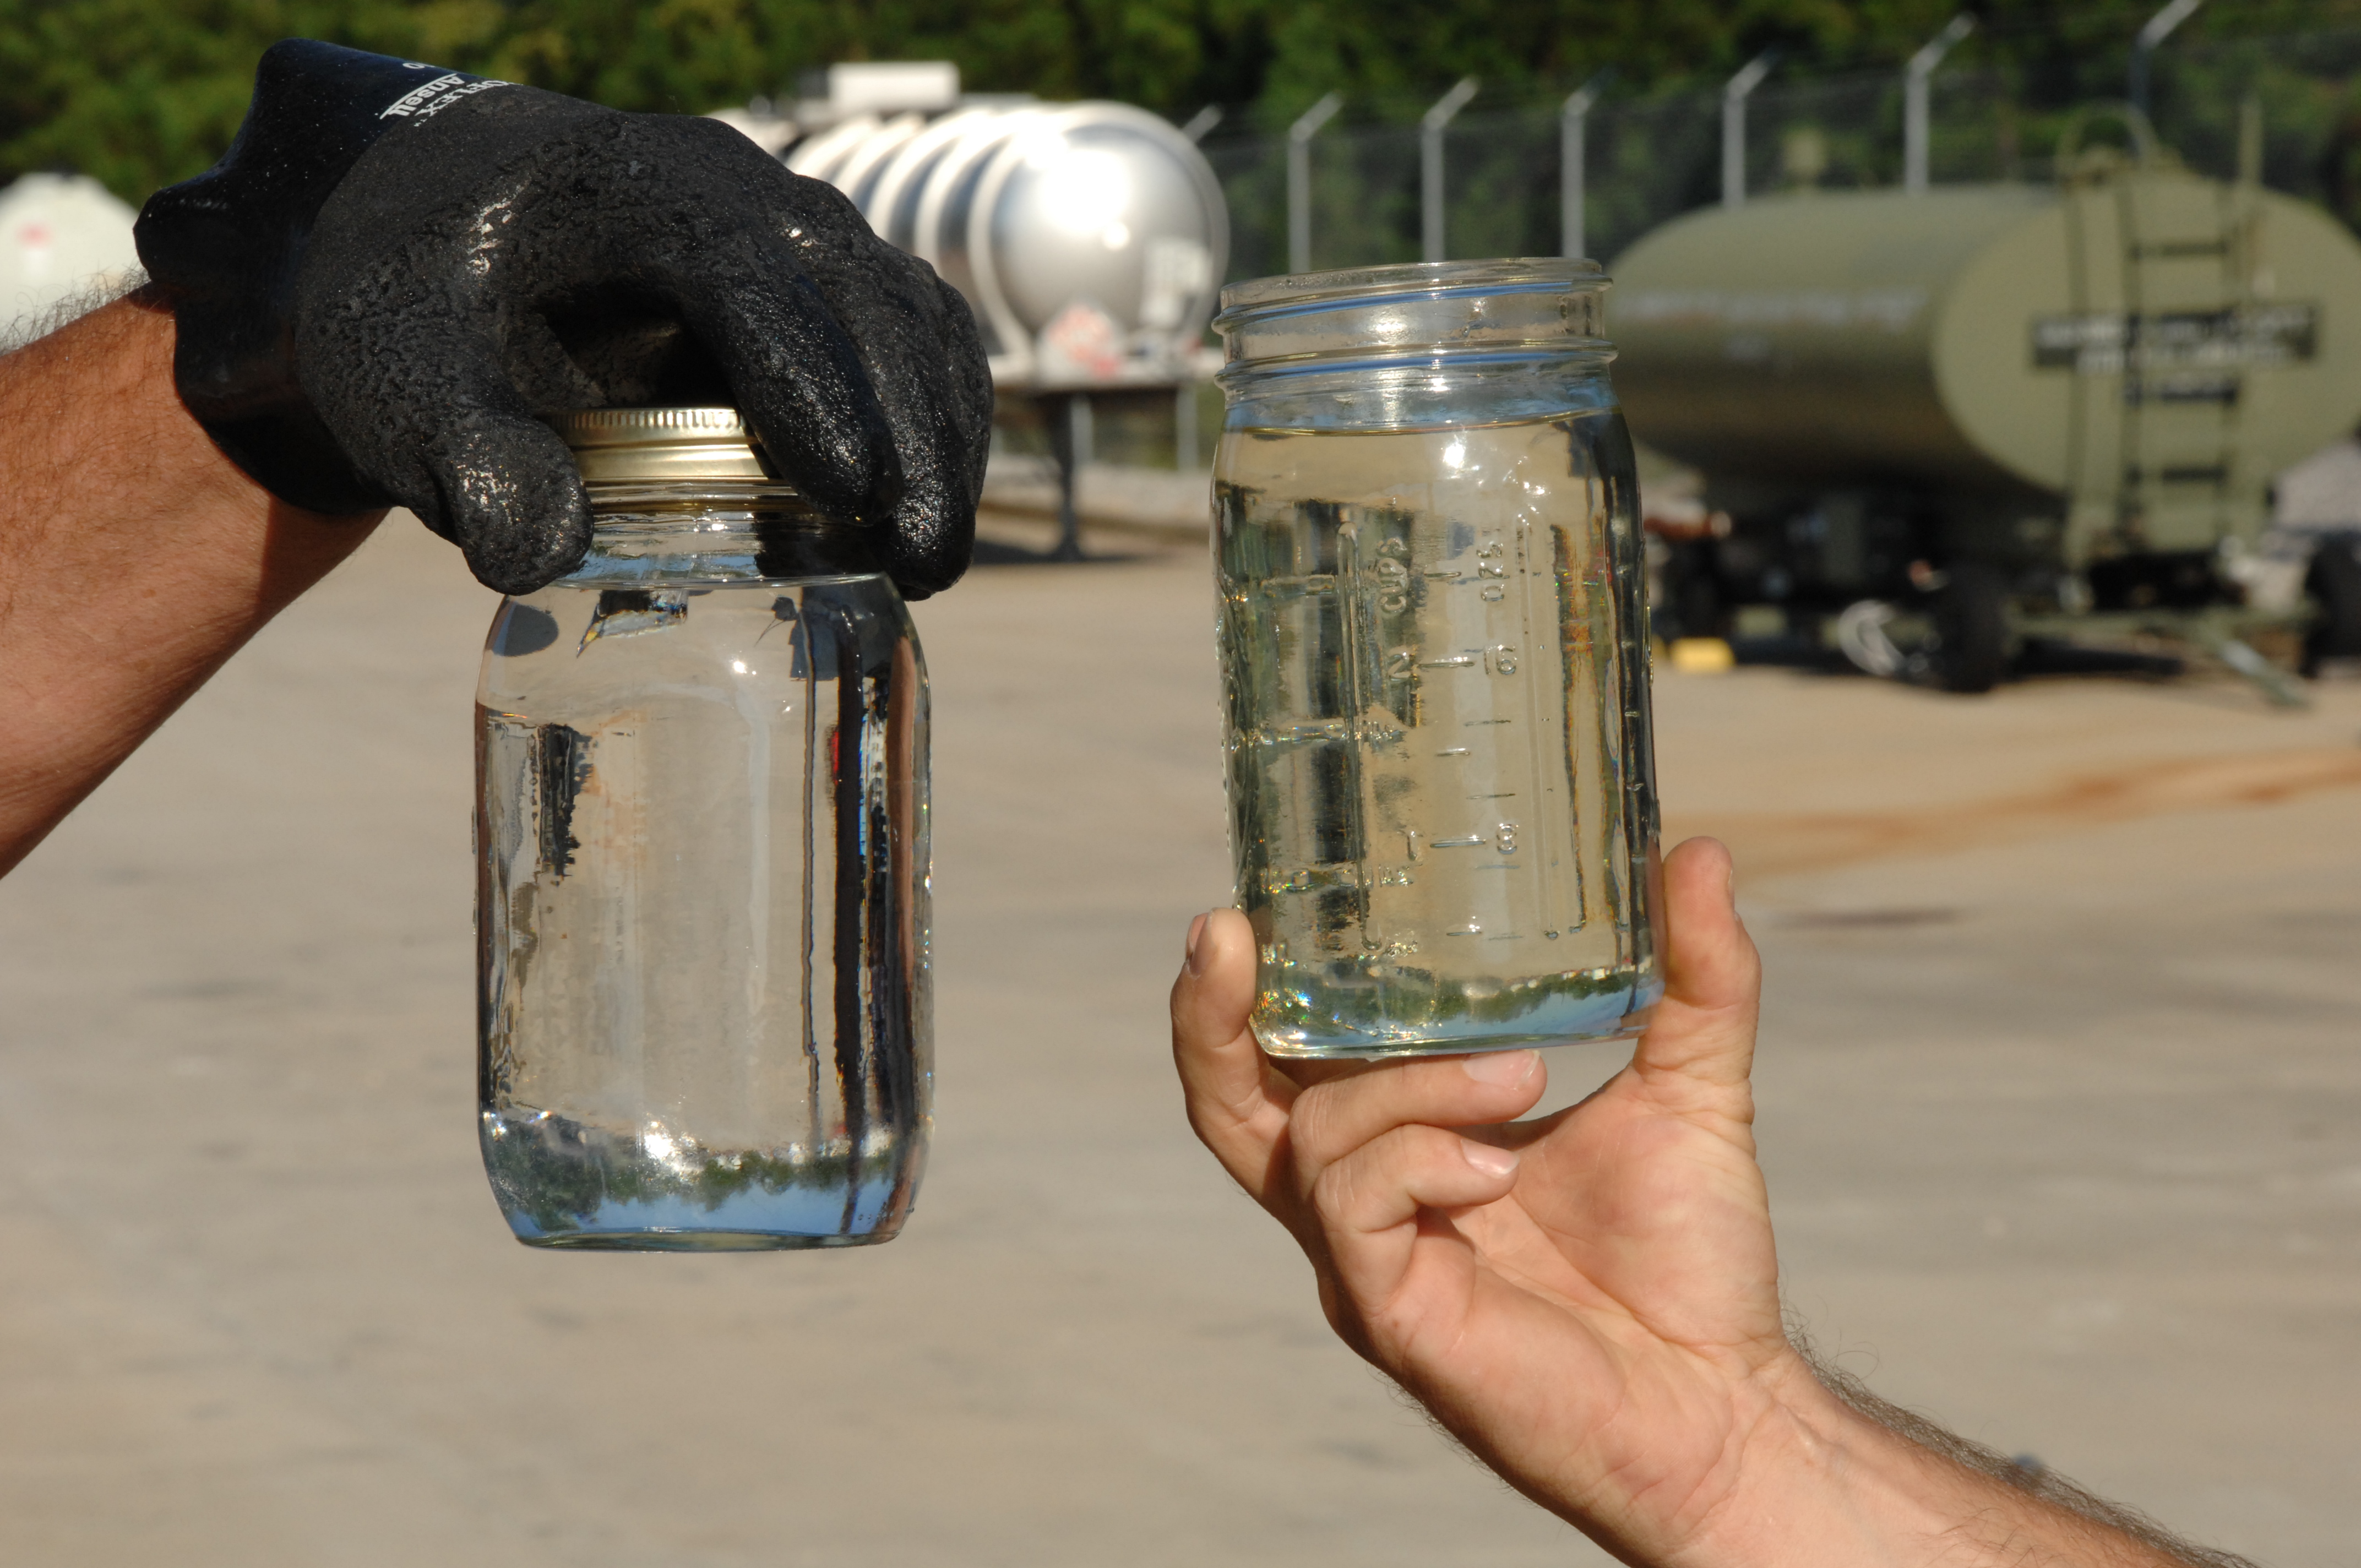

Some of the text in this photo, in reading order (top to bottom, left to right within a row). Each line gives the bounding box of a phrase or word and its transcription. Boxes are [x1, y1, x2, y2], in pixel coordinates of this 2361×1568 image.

[388, 76, 465, 116] Ansell
[1377, 537, 1407, 614] CUPS
[1387, 649, 1412, 682] 2
[1483, 645, 1516, 676] 16
[1496, 823, 1519, 855] 8
